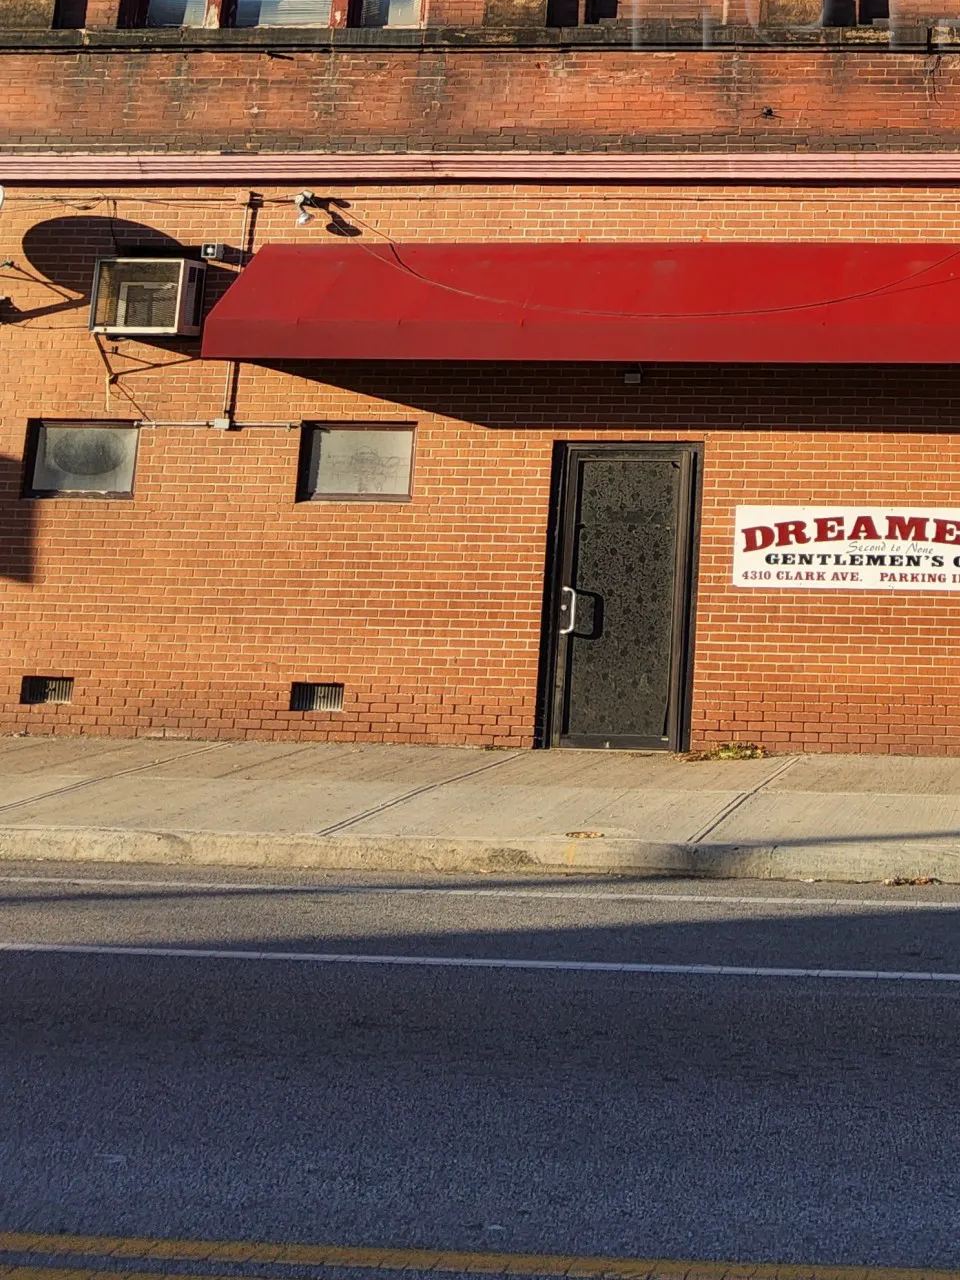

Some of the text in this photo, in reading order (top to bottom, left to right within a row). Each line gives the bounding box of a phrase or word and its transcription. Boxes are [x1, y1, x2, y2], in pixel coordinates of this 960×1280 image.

[846, 541, 934, 555] Second to None
[765, 553, 944, 568] GENTLEMEN'S
[741, 570, 771, 580] 4310
[776, 571, 826, 581] CLARK
[831, 571, 863, 582] AVE.
[879, 572, 947, 583] PARKING
